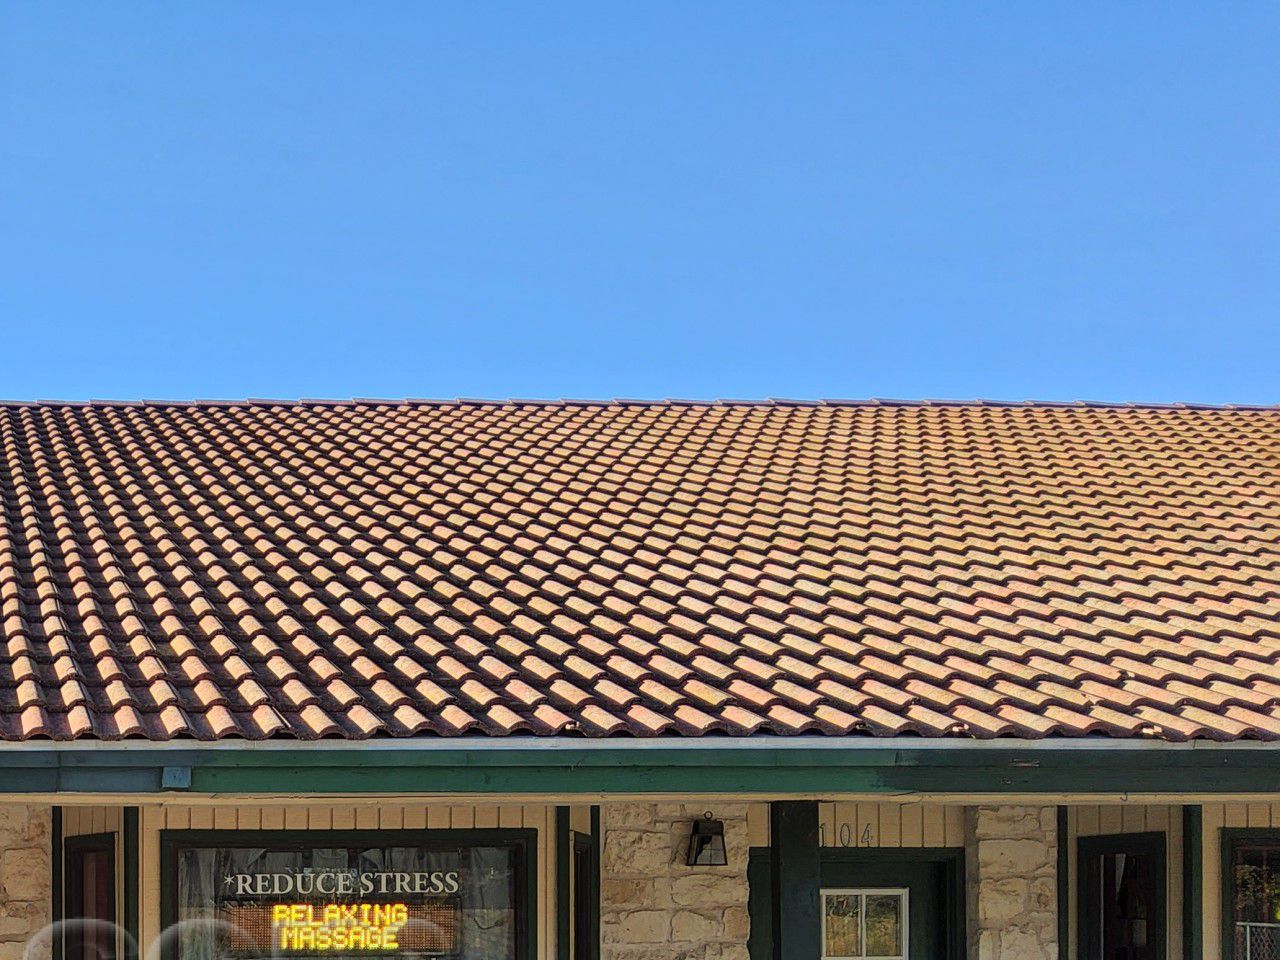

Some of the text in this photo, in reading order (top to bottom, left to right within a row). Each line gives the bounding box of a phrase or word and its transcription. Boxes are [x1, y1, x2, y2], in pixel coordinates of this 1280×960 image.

[360, 871, 459, 895] STRESS
[272, 903, 409, 926] RELAXING
[280, 926, 400, 950] MASSAGE
